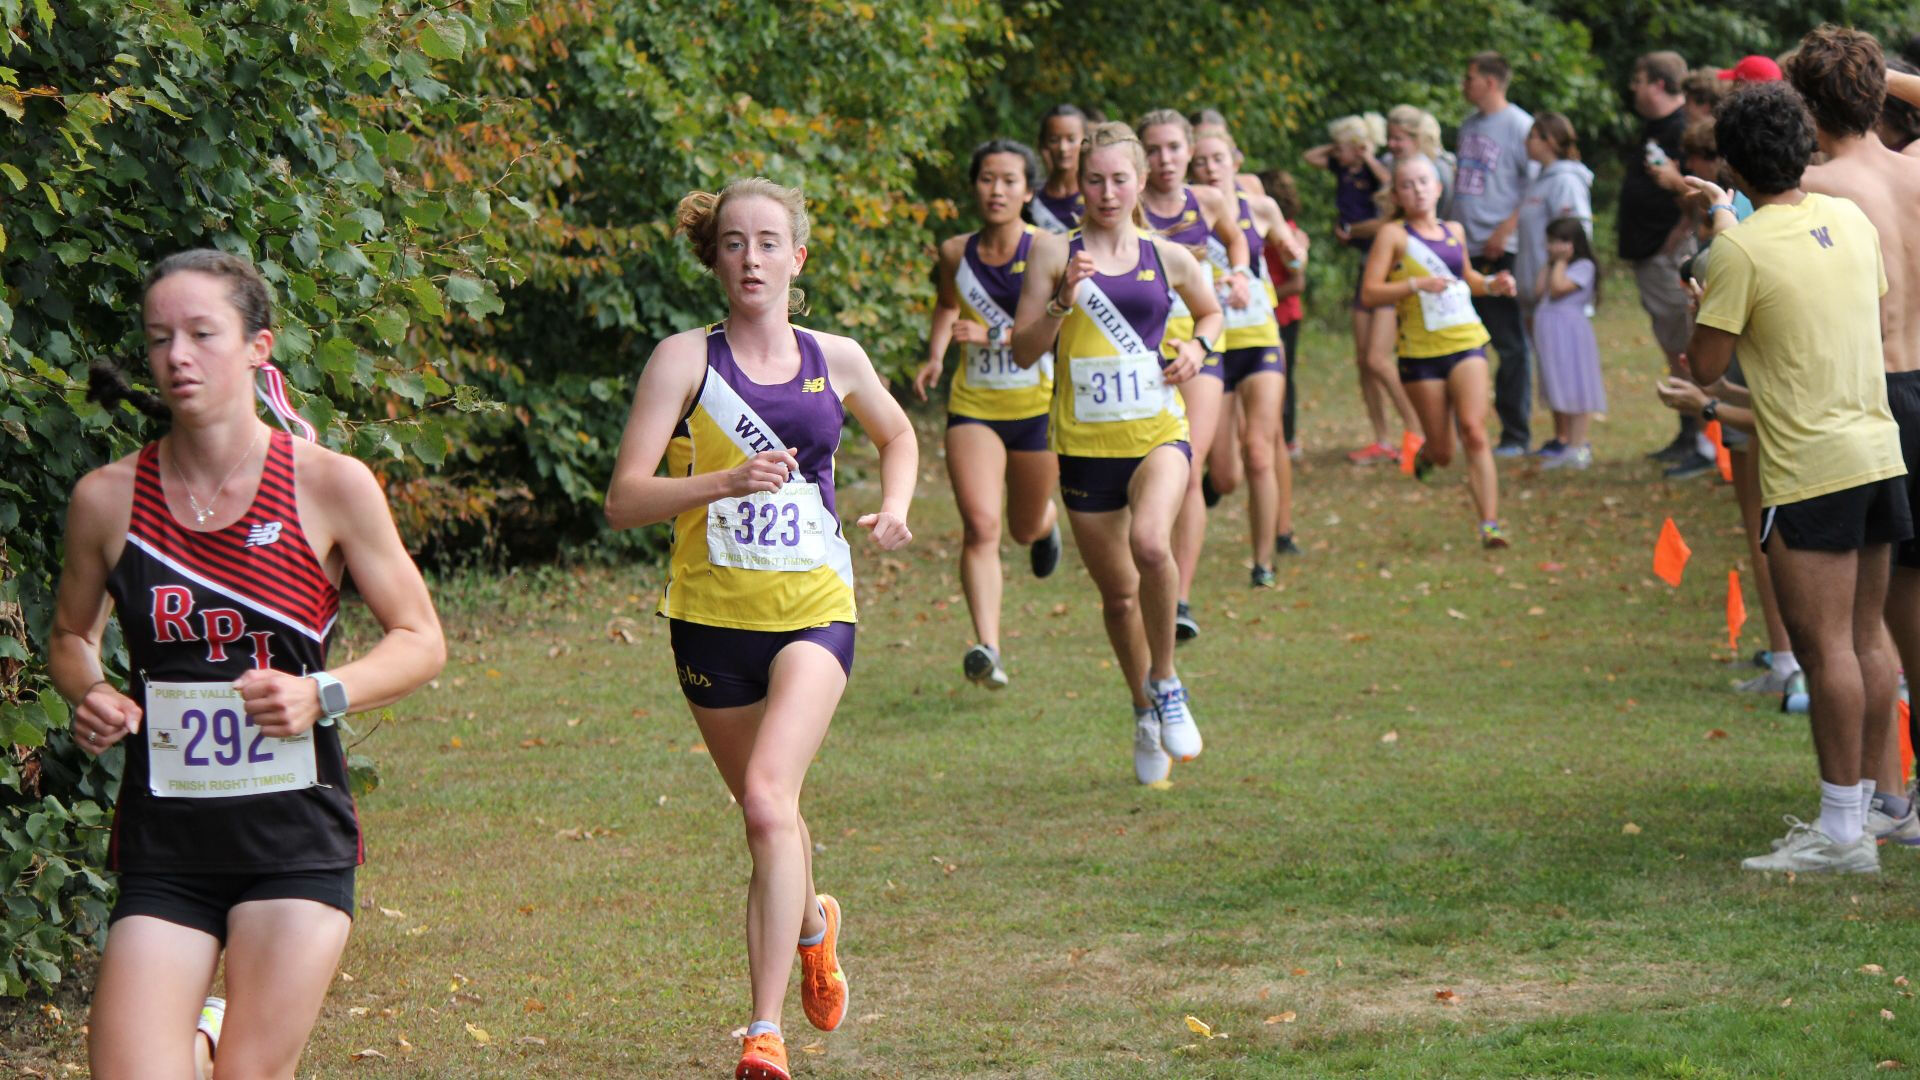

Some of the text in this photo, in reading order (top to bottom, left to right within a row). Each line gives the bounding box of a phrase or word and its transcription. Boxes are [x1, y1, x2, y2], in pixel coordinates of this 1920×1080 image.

[1809, 226, 1834, 249] W
[1087, 293, 1142, 354] WILLIA
[1091, 370, 1140, 404] 311
[734, 501, 801, 547] 323
[783, 557, 814, 566] TIMING
[151, 584, 275, 670] RPI
[155, 688, 242, 699] PURPLE VALLE
[181, 708, 274, 767] 292
[168, 772, 296, 791] FINISH RIGHT TIMING
